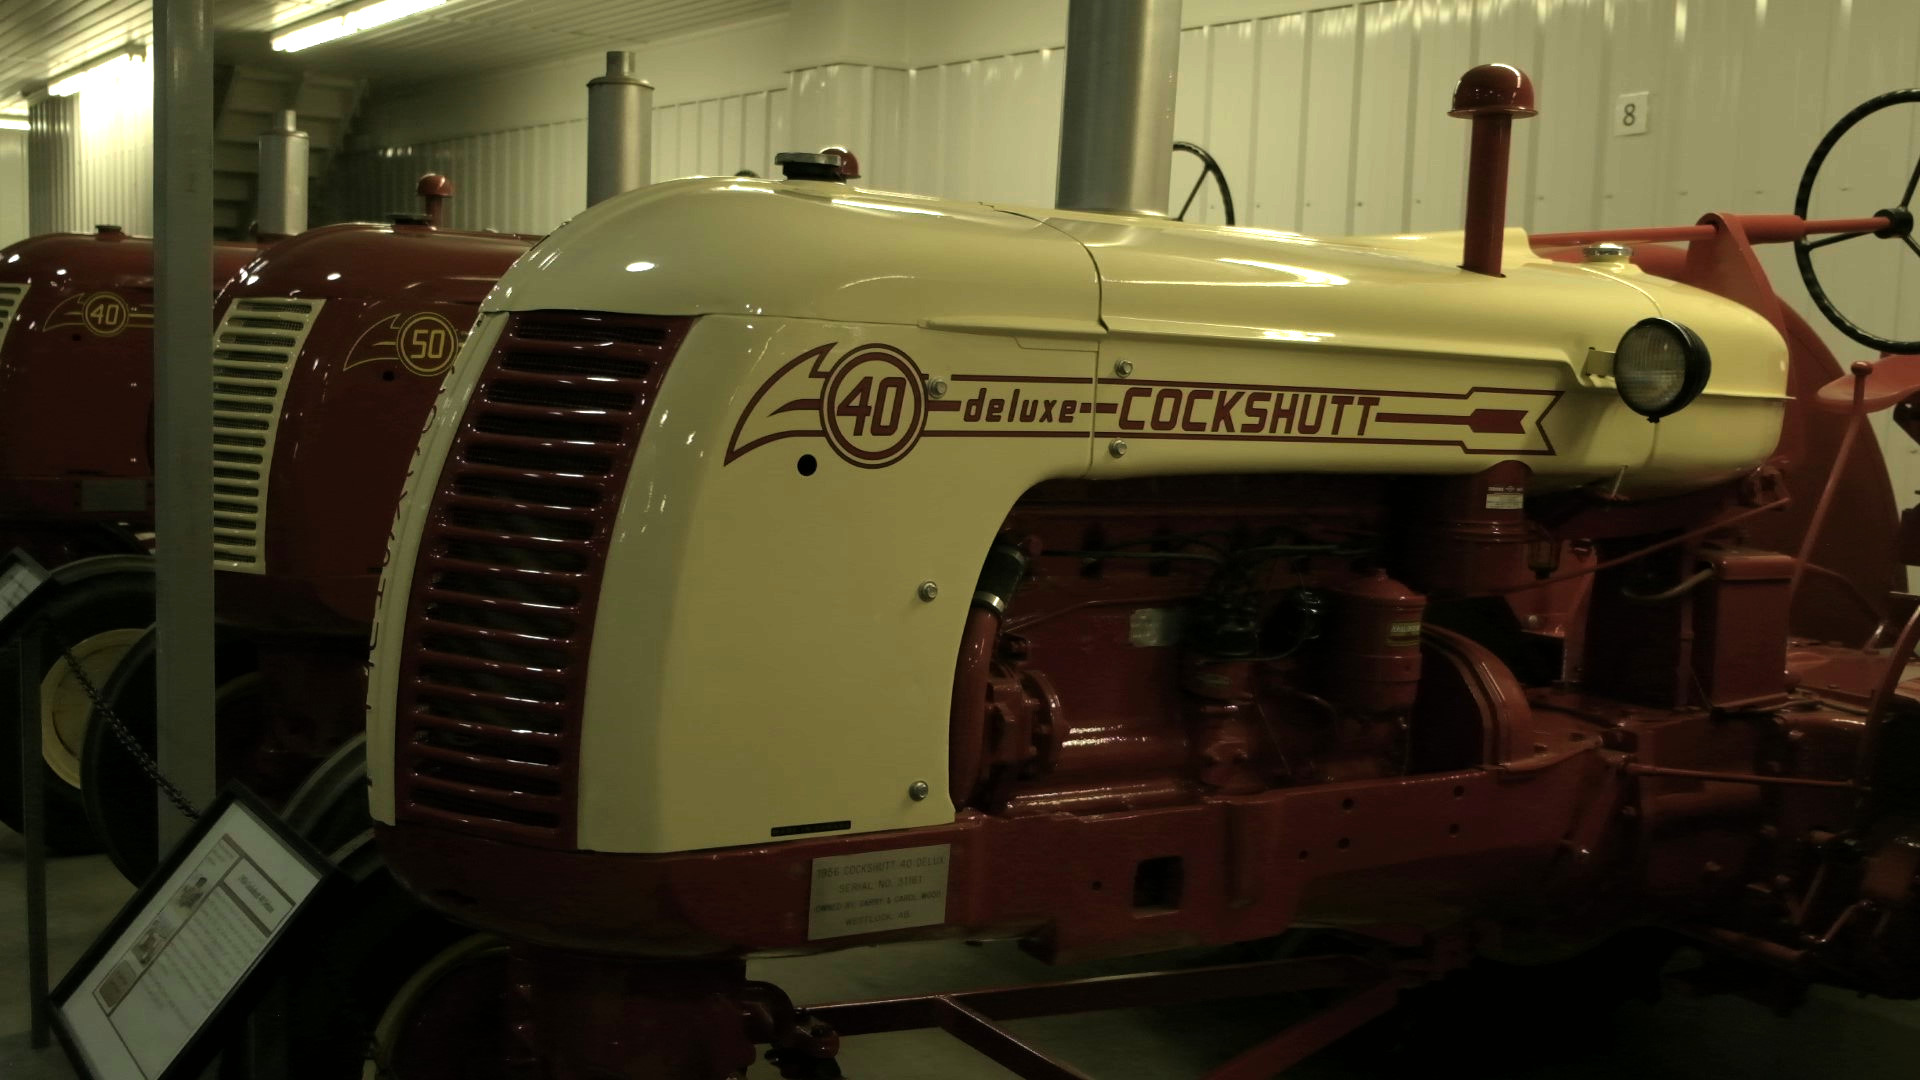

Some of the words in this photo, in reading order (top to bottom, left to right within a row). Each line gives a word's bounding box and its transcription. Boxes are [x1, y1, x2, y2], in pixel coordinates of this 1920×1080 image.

[1623, 103, 1635, 127] 8
[90, 303, 120, 326] 40
[410, 329, 446, 359] 50
[836, 376, 907, 436] 40
[963, 387, 1077, 423] deluxe
[1118, 386, 1381, 436] COCKSHUTT
[844, 859, 896, 876] COCKSHUTT
[900, 858, 912, 869] 40
[839, 881, 873, 894] SERIAL
